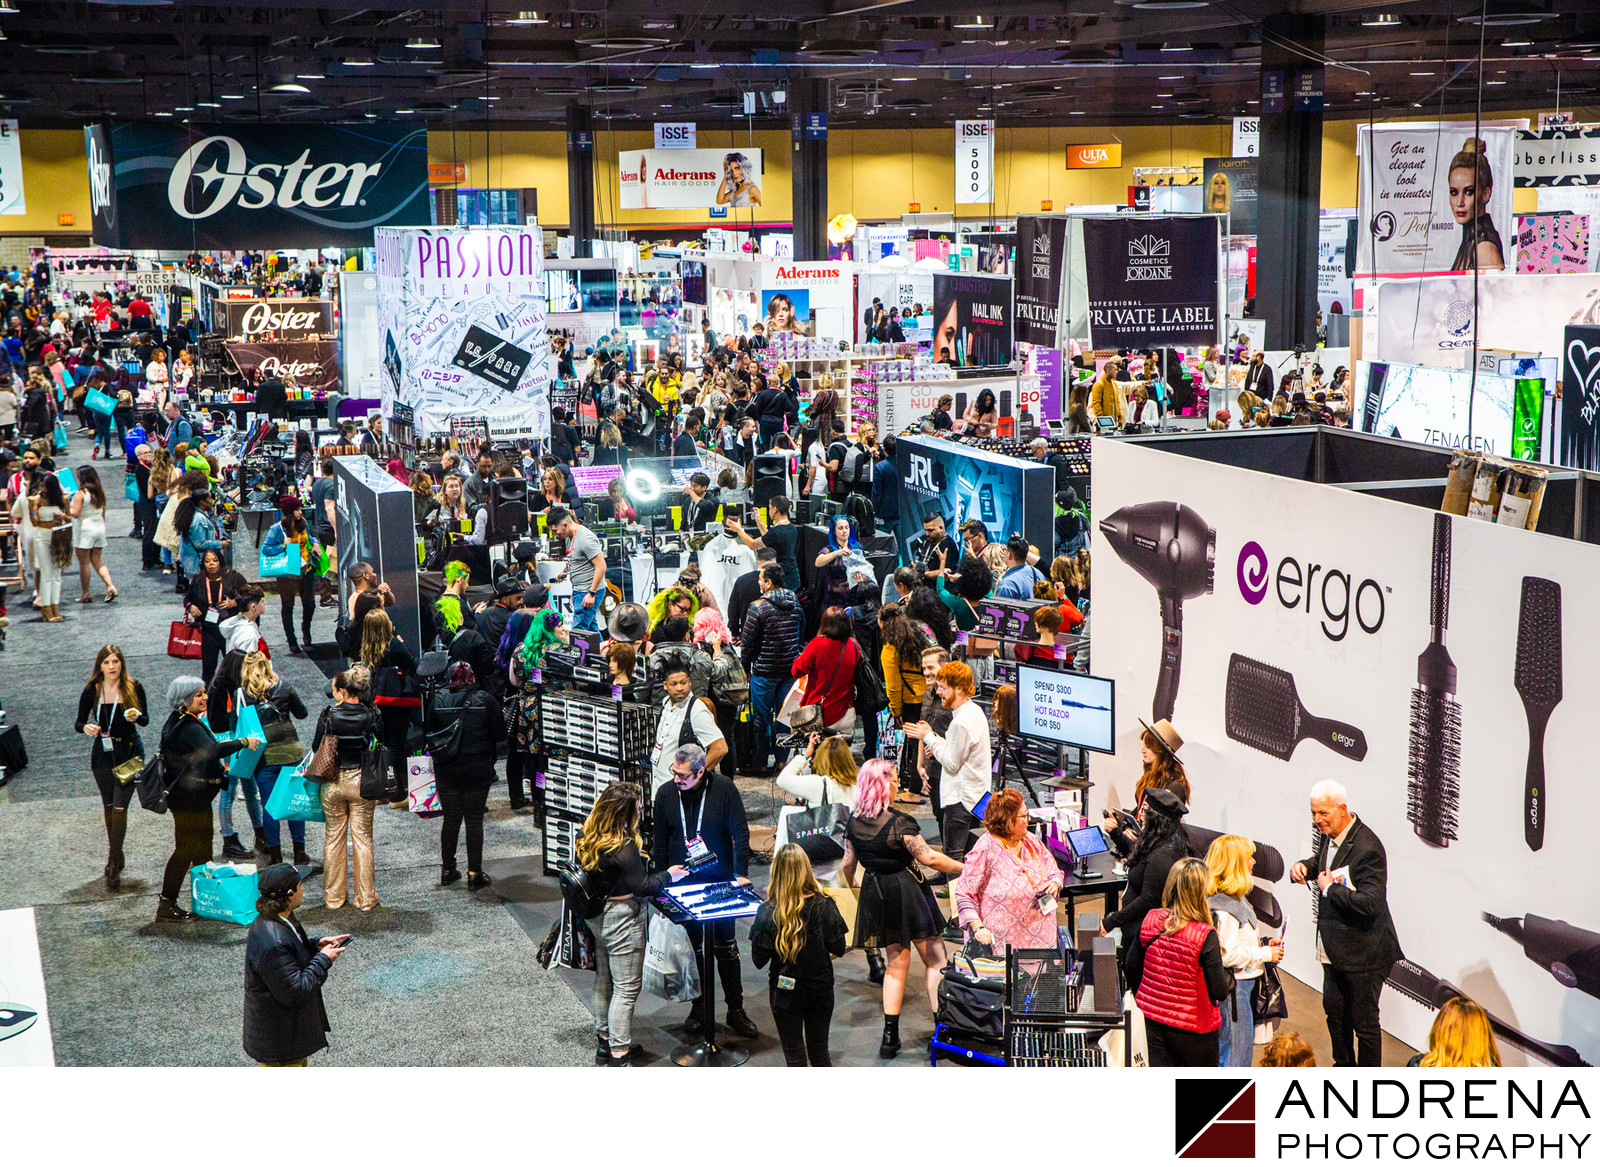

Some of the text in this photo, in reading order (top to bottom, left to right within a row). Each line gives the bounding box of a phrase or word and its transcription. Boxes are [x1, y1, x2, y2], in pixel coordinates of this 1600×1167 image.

[661, 127, 689, 140] ISSE
[962, 124, 988, 136] ISSE
[1083, 148, 1109, 160] ULTA
[1391, 140, 1425, 159] Get an
[1388, 157, 1426, 174] elegant
[168, 135, 382, 220] Oster
[655, 167, 717, 180] Aderans
[1396, 172, 1417, 186] look
[1379, 188, 1432, 199] in minutes
[1431, 222, 1455, 231] HAIRDOS
[418, 233, 533, 279] PASSION
[1129, 257, 1169, 265] COSMETICS
[775, 265, 840, 280] Aderans
[1125, 265, 1173, 282] JORDANE
[1317, 264, 1343, 273] RGANIC
[136, 273, 177, 284] KREST
[775, 277, 840, 286] HAIR GOODS
[138, 284, 172, 295] COMB
[419, 281, 533, 298] BEAUTY
[241, 302, 321, 335] Oster
[972, 302, 1004, 321] NAIL INK
[1161, 306, 1214, 324] LABEL
[1149, 324, 1214, 332] MANUFACTURING
[514, 373, 548, 392] onetsu
[910, 385, 932, 397] GO
[1021, 391, 1040, 403] BO
[910, 397, 939, 409] NUD
[886, 388, 894, 438] CHRISTR
[490, 427, 518, 436] AVAILABLE
[519, 426, 532, 434] HERE
[904, 482, 940, 500] PROFESSIONAL
[1275, 555, 1387, 642] ergo
[1034, 680, 1072, 695] SPEND $300
[1034, 693, 1053, 704] GET A
[1034, 706, 1070, 719] HOT RAZOR
[1034, 717, 1061, 731] FOR $50
[1337, 733, 1354, 748] ergo
[1530, 797, 1539, 826] ergo
[796, 825, 831, 841] SPARKS
